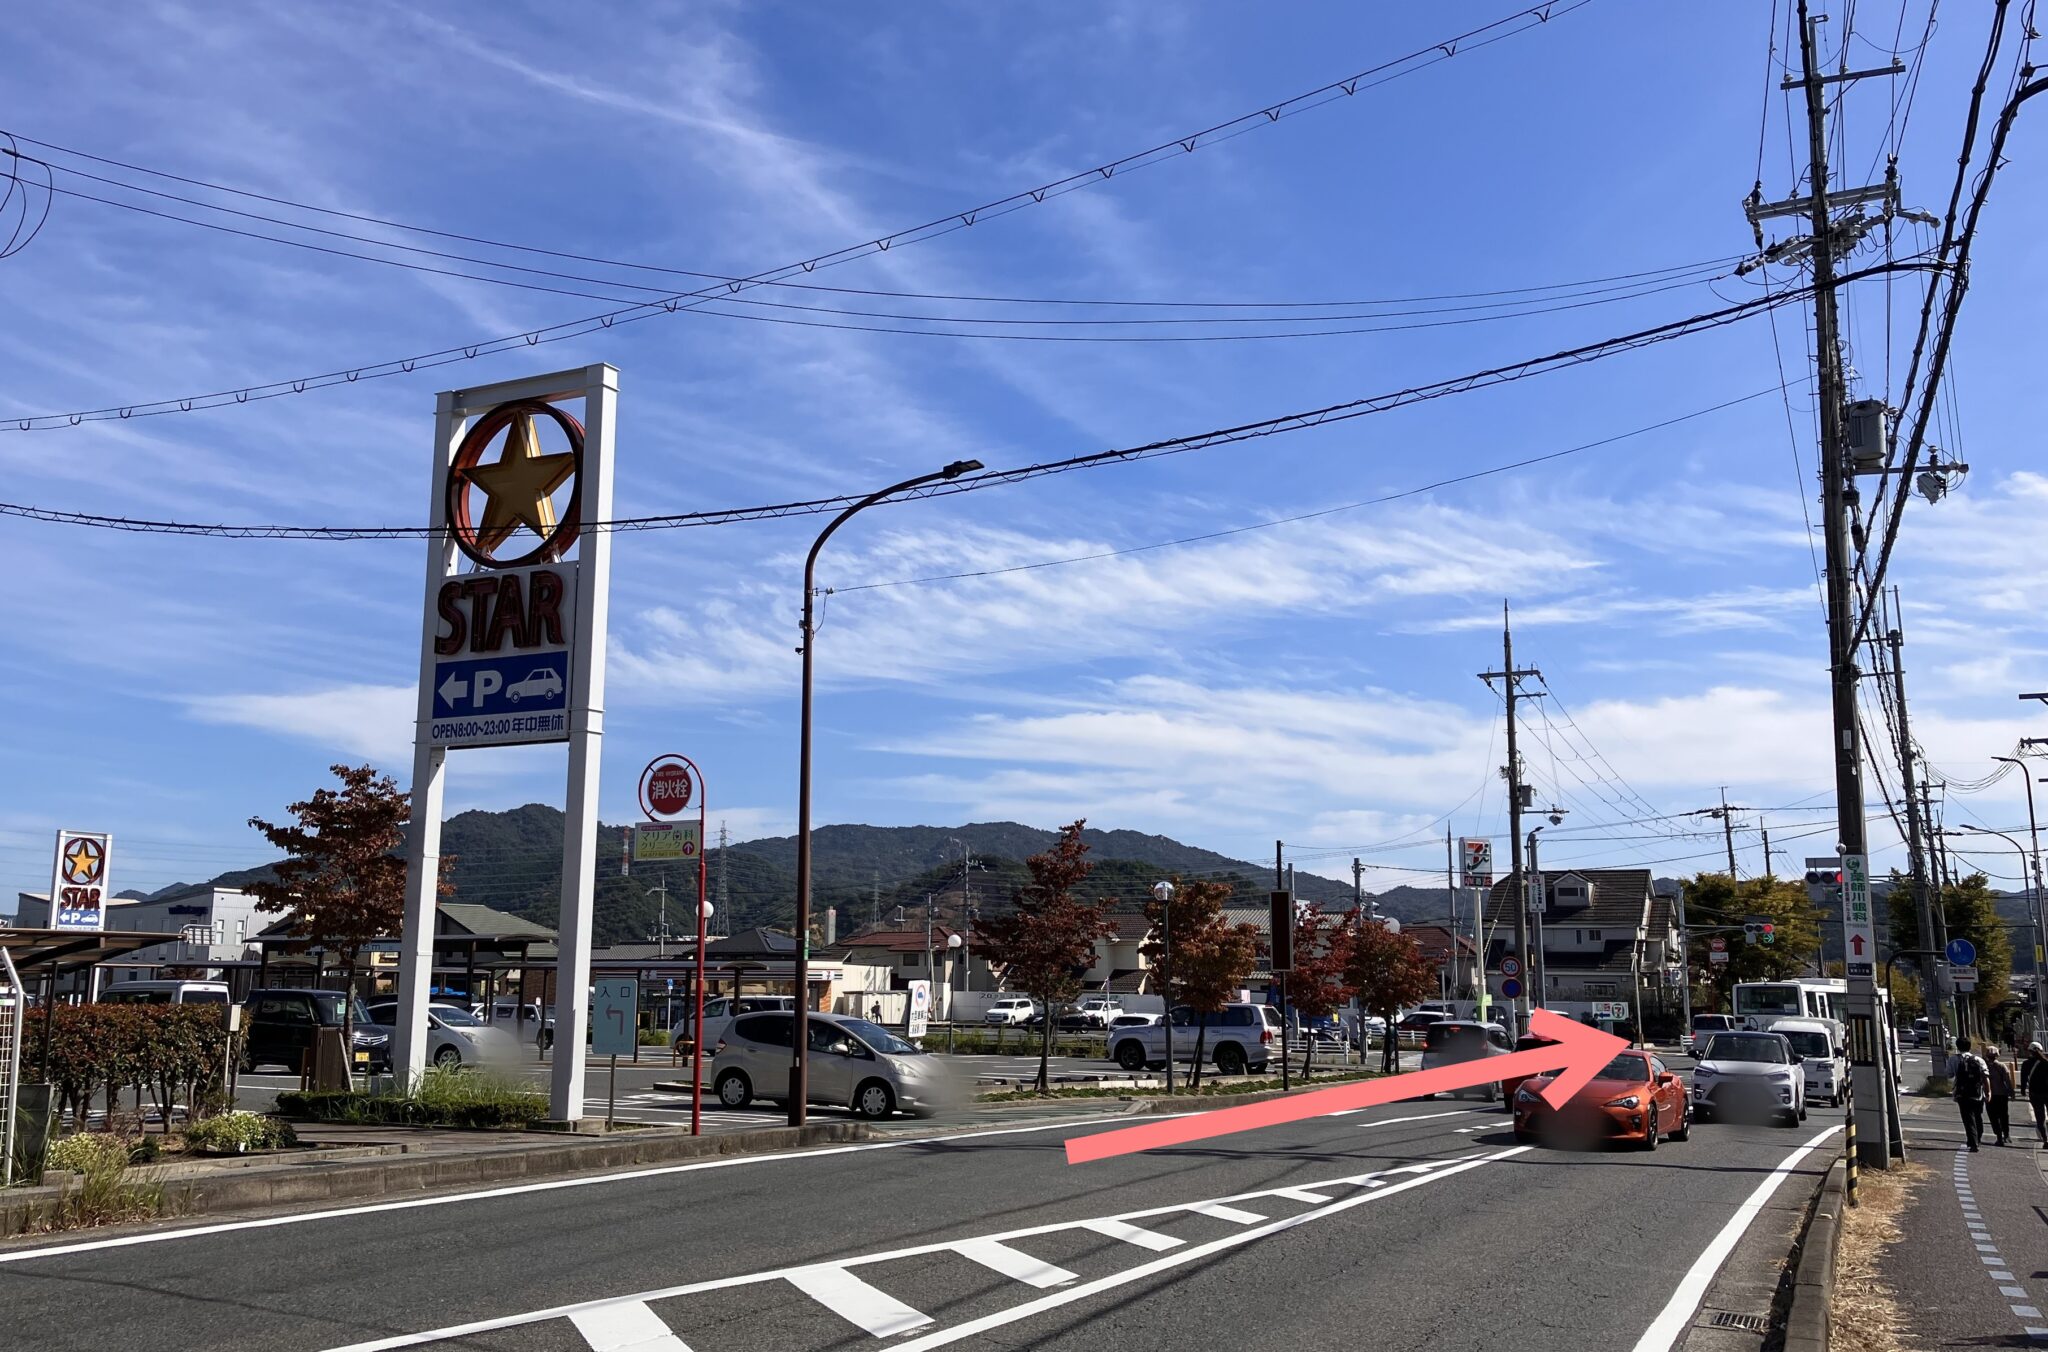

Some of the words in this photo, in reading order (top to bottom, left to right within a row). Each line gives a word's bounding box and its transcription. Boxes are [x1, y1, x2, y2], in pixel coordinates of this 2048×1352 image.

[434, 570, 565, 655] STAR
[473, 670, 503, 708] P
[512, 714, 564, 733] 年中無休
[652, 778, 688, 800] 消火栓
[640, 829, 694, 842] マリア歯科
[60, 887, 100, 910] STAR
[70, 913, 80, 923] P
[1504, 962, 1517, 972] 50
